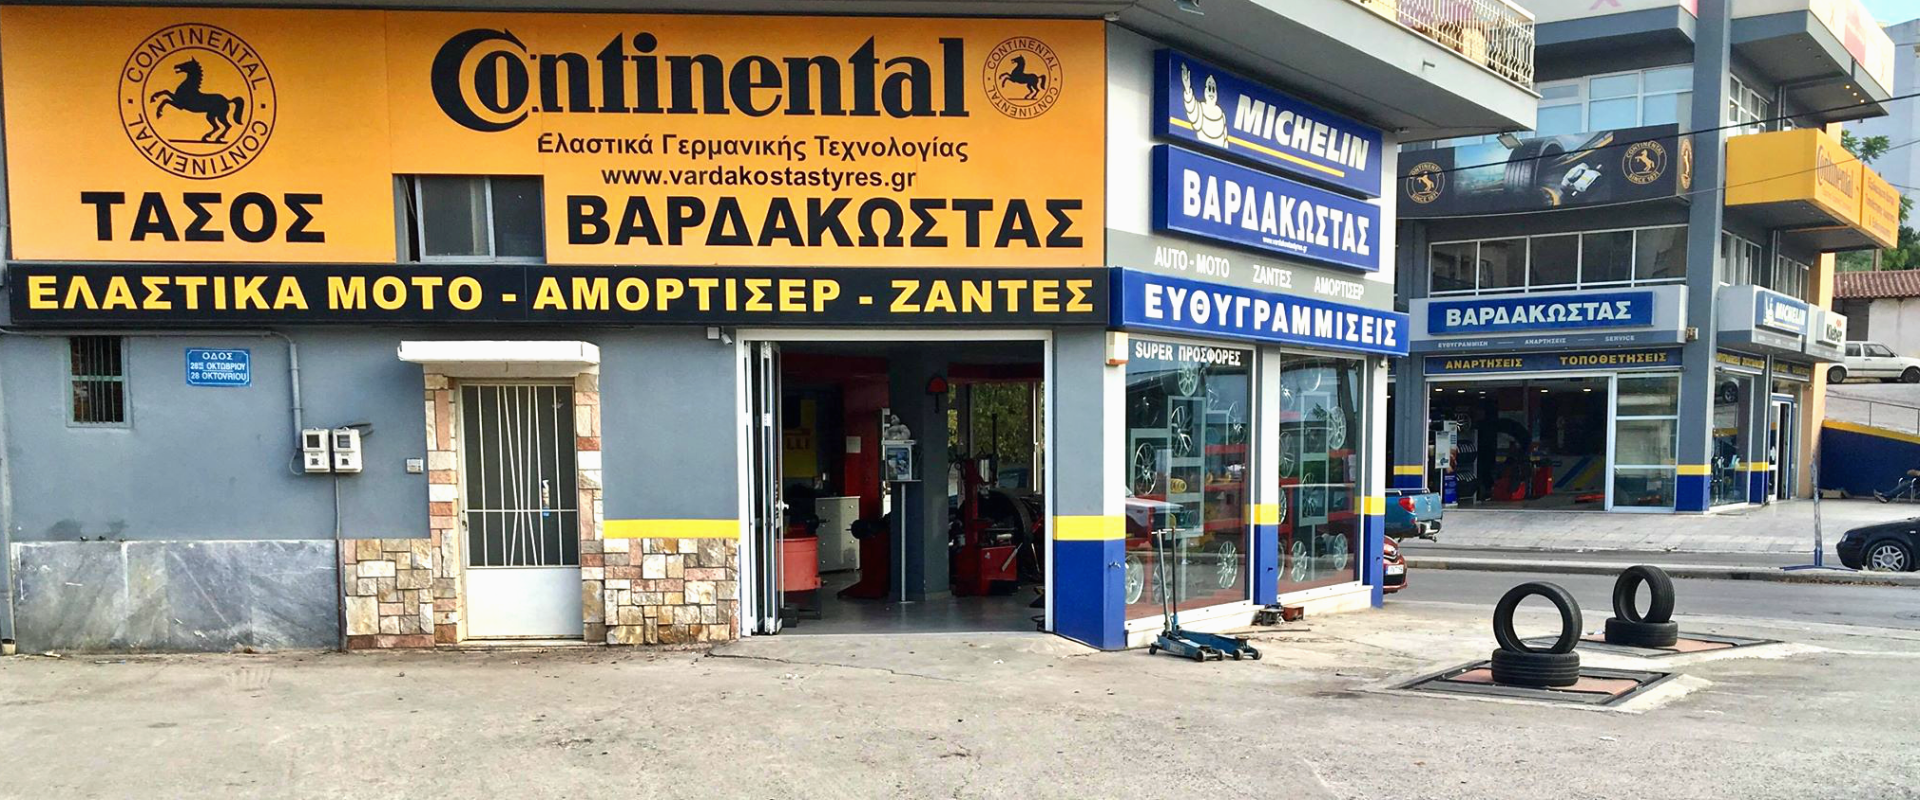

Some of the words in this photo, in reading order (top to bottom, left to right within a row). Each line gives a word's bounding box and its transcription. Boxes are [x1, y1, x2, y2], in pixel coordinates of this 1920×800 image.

[126, 28, 267, 91] CONTINENTAL
[987, 39, 1058, 72] CONTINENTAL
[430, 28, 969, 133] Continental
[988, 85, 1058, 117] CONTINENTAL
[128, 113, 268, 176] CONTINENTAL
[537, 133, 653, 155] Ελαστικά
[662, 134, 806, 162] Γερμανικής
[814, 135, 969, 162] Τεχνολογίας
[1233, 94, 1370, 172] MICHELIN
[601, 166, 917, 192] www.vardakostastyres.gr
[81, 191, 325, 243] ΤΑΣΟΣ
[567, 195, 1083, 248] ΒΑΡΔΑΚΩΣΤΑΣ
[1183, 169, 1370, 256] ΒΑΡΔΑΚΩΣΤΑΣ
[1154, 246, 1188, 270] AUTO
[1197, 254, 1230, 278] MOTO
[1253, 265, 1292, 288] ΖΑΝΤΕΣ
[29, 275, 308, 310] ΕΛΑΣΤΙΚΑ
[328, 276, 483, 310] ΜΟΤΟ
[501, 293, 517, 302] -
[533, 277, 840, 312] ΑΜΟΡΤΙΣΕΡ
[859, 296, 873, 304] -
[890, 279, 1094, 313] ΖΑΝΤΕΣ
[1314, 276, 1364, 301] ΑΜΟΡΤΙΣΕΡ
[1144, 283, 1397, 347] ΕΥΘΥΓΡΑΜΜΙΣΕΙΣ
[1446, 301, 1631, 327] ΒΑΡΔΑΚΩΣΤΑΣ
[202, 352, 233, 360] ΟΔΟΣ
[206, 362, 246, 370] ΟΚΤΩΒΡΙΟΥ
[1135, 342, 1173, 361] SUPER
[1178, 345, 1241, 366] ΠΡΟΣΦΟΡΕΣ
[1445, 358, 1523, 370] ΑΝΑΡΤΗΣΕΙΣ
[1560, 352, 1667, 366] ΤΟΠΟΘΕΤΗΣΕΙΣ
[190, 372, 200, 380] 28
